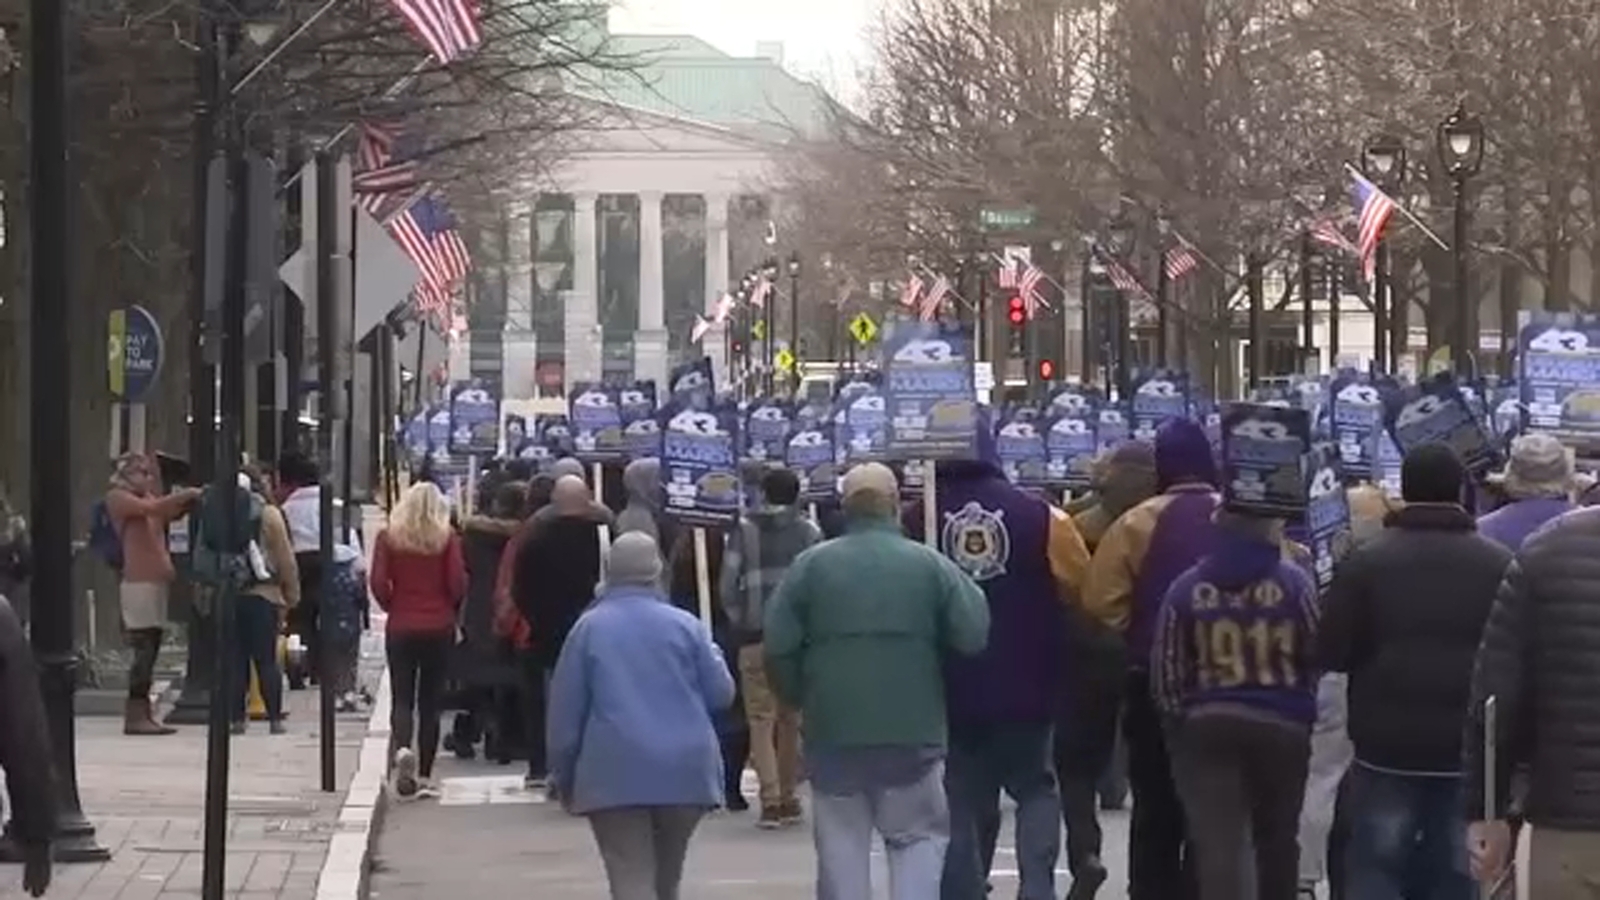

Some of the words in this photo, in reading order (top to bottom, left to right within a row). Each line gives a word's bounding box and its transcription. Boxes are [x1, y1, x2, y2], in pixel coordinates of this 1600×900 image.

[126, 335, 148, 346] PAY
[126, 347, 141, 358] TO
[126, 359, 154, 370] PARK
[1194, 617, 1297, 687] 1911
